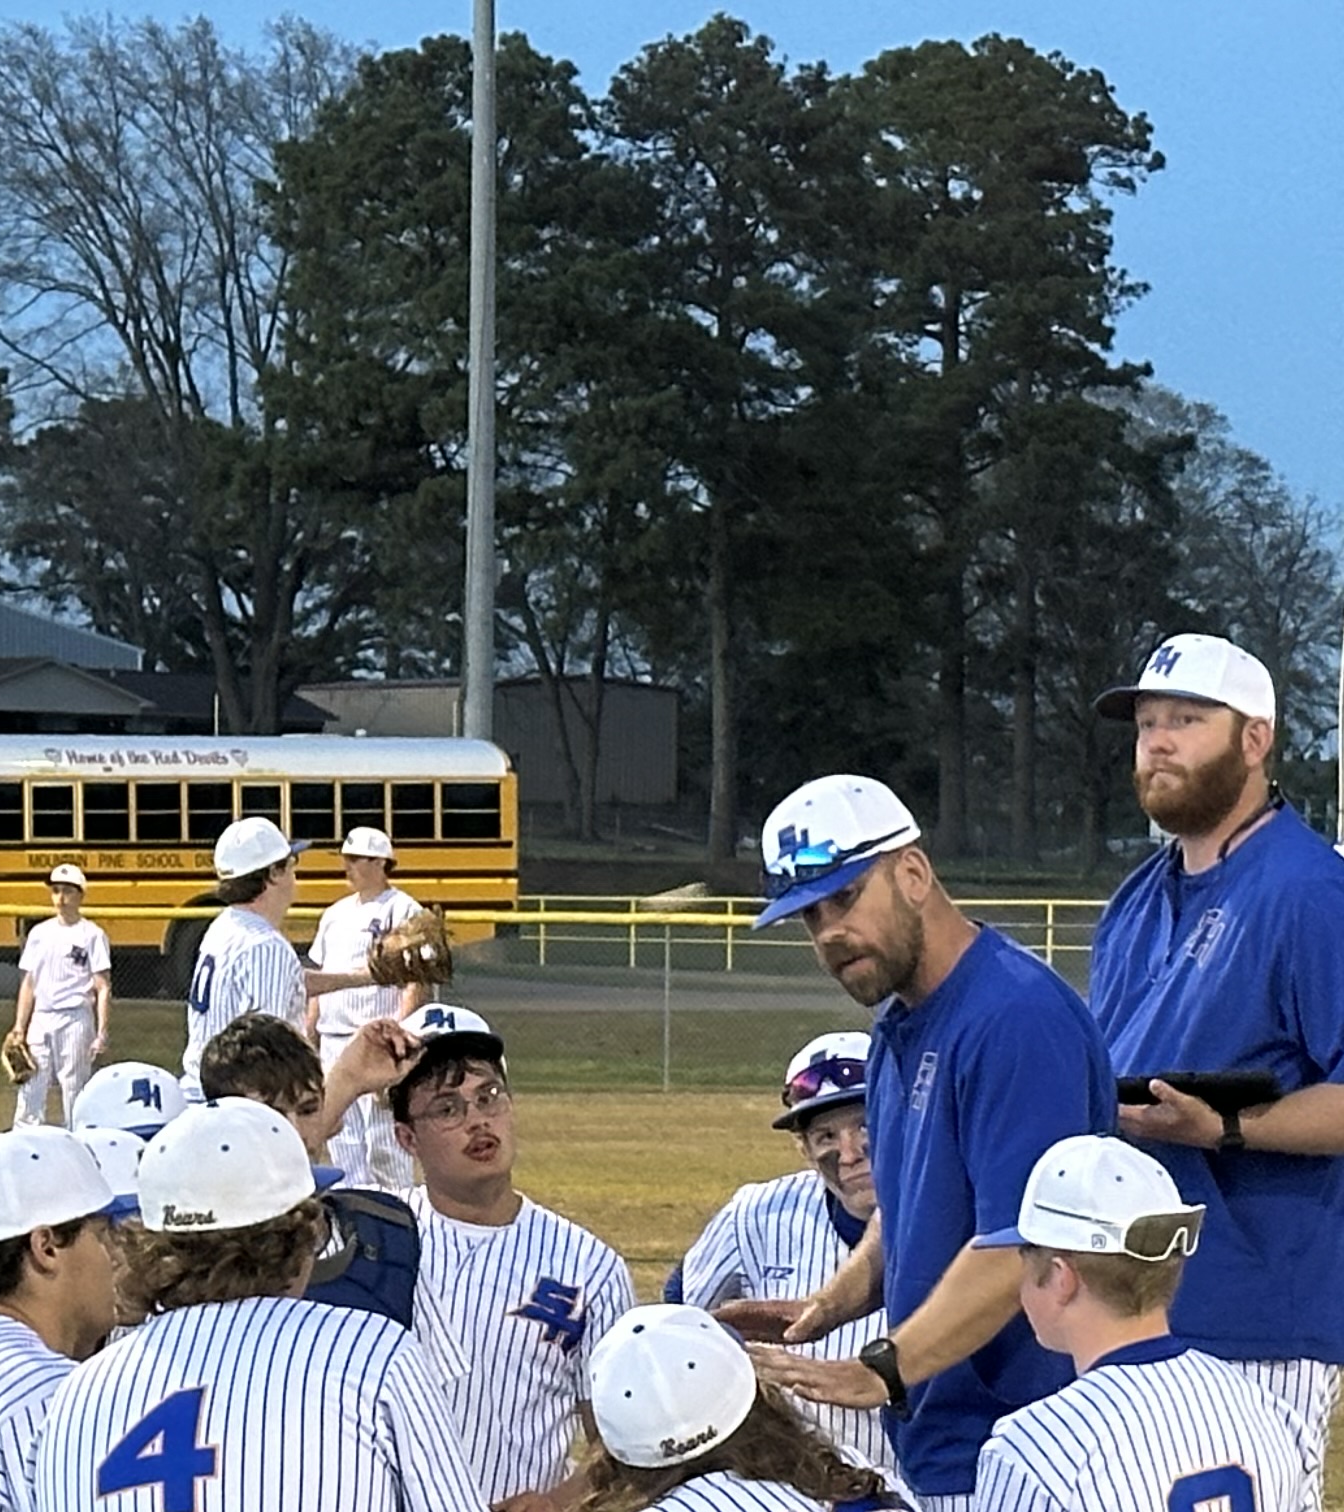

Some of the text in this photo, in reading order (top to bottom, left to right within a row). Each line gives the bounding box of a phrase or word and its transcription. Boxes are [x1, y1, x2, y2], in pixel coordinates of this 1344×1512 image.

[66, 749, 229, 767] Home of the Red Devils
[98, 853, 125, 868] PINE
[137, 853, 184, 868] SCHOOL
